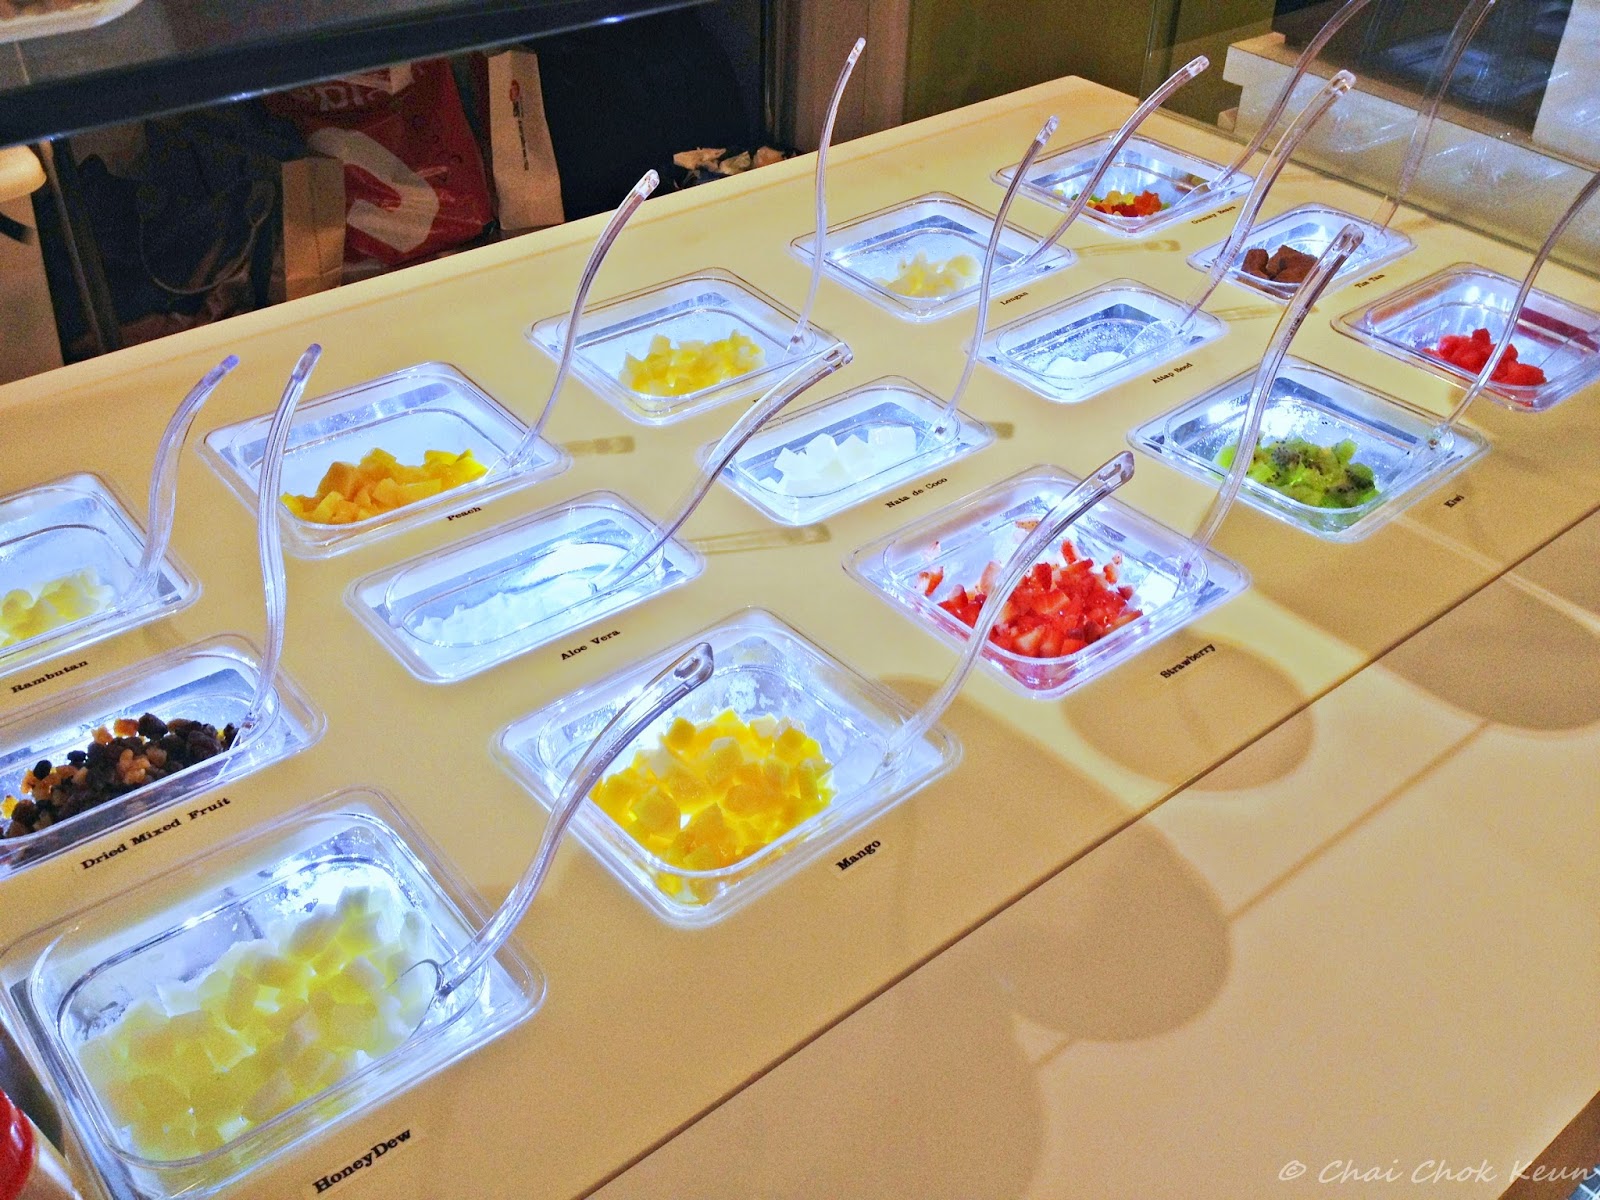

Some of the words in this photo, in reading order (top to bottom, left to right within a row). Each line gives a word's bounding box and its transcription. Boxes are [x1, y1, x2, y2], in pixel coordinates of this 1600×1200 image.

[885, 496, 910, 508] Nata
[925, 477, 948, 489] Coco
[1443, 494, 1465, 508] Kiwi
[446, 507, 482, 521] Peach
[561, 645, 588, 660] Aloe
[589, 630, 621, 644] Vera
[11, 660, 88, 693] Rambutan
[1160, 643, 1216, 679] Strawberry
[80, 843, 128, 870] Dried
[130, 818, 181, 846] Mixed
[187, 797, 231, 821] Fruit
[835, 840, 881, 870] Mango
[312, 1129, 411, 1193] HoneyDew
